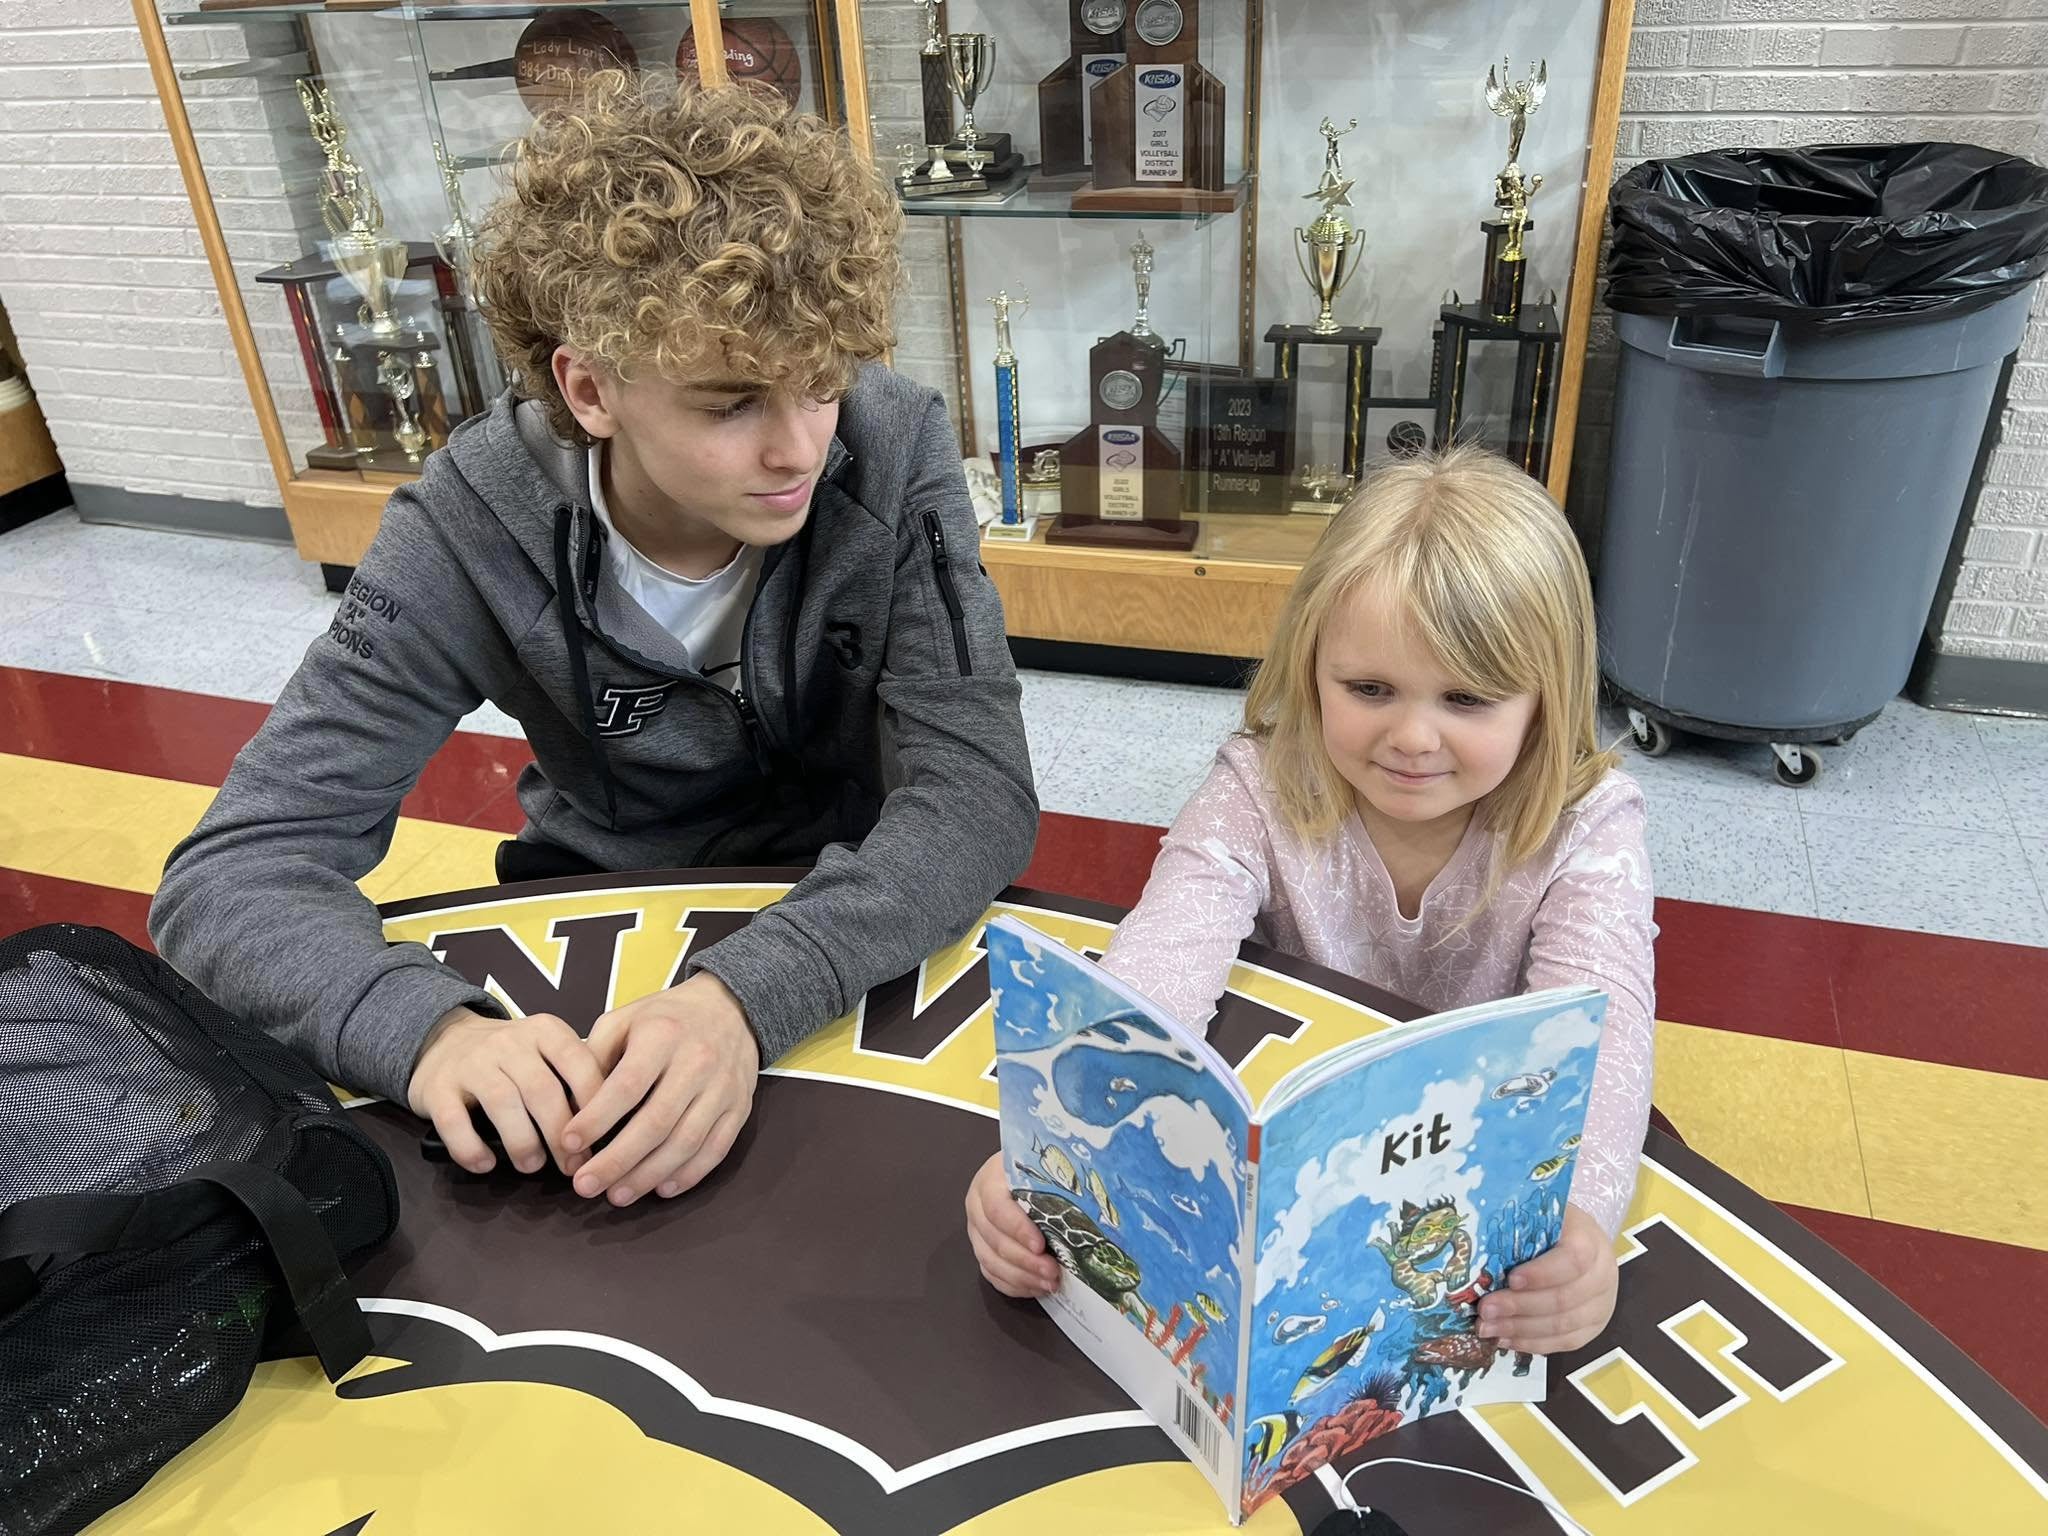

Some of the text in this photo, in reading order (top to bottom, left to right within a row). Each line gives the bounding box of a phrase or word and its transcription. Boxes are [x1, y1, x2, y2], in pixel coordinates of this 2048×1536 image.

[1145, 74, 1176, 85] KHSAA
[1152, 130, 1167, 138] 2017
[1150, 140, 1169, 148] GIRLS
[1141, 150, 1179, 158] VOLLEYBALL
[1142, 169, 1178, 177] RUNNER-UP
[1228, 398, 1251, 416] 2023
[1213, 423, 1266, 446] 13th Region
[1232, 448, 1276, 471] Volleyball
[1213, 473, 1260, 496] Runner-up
[1381, 1112, 1452, 1175] Kit
